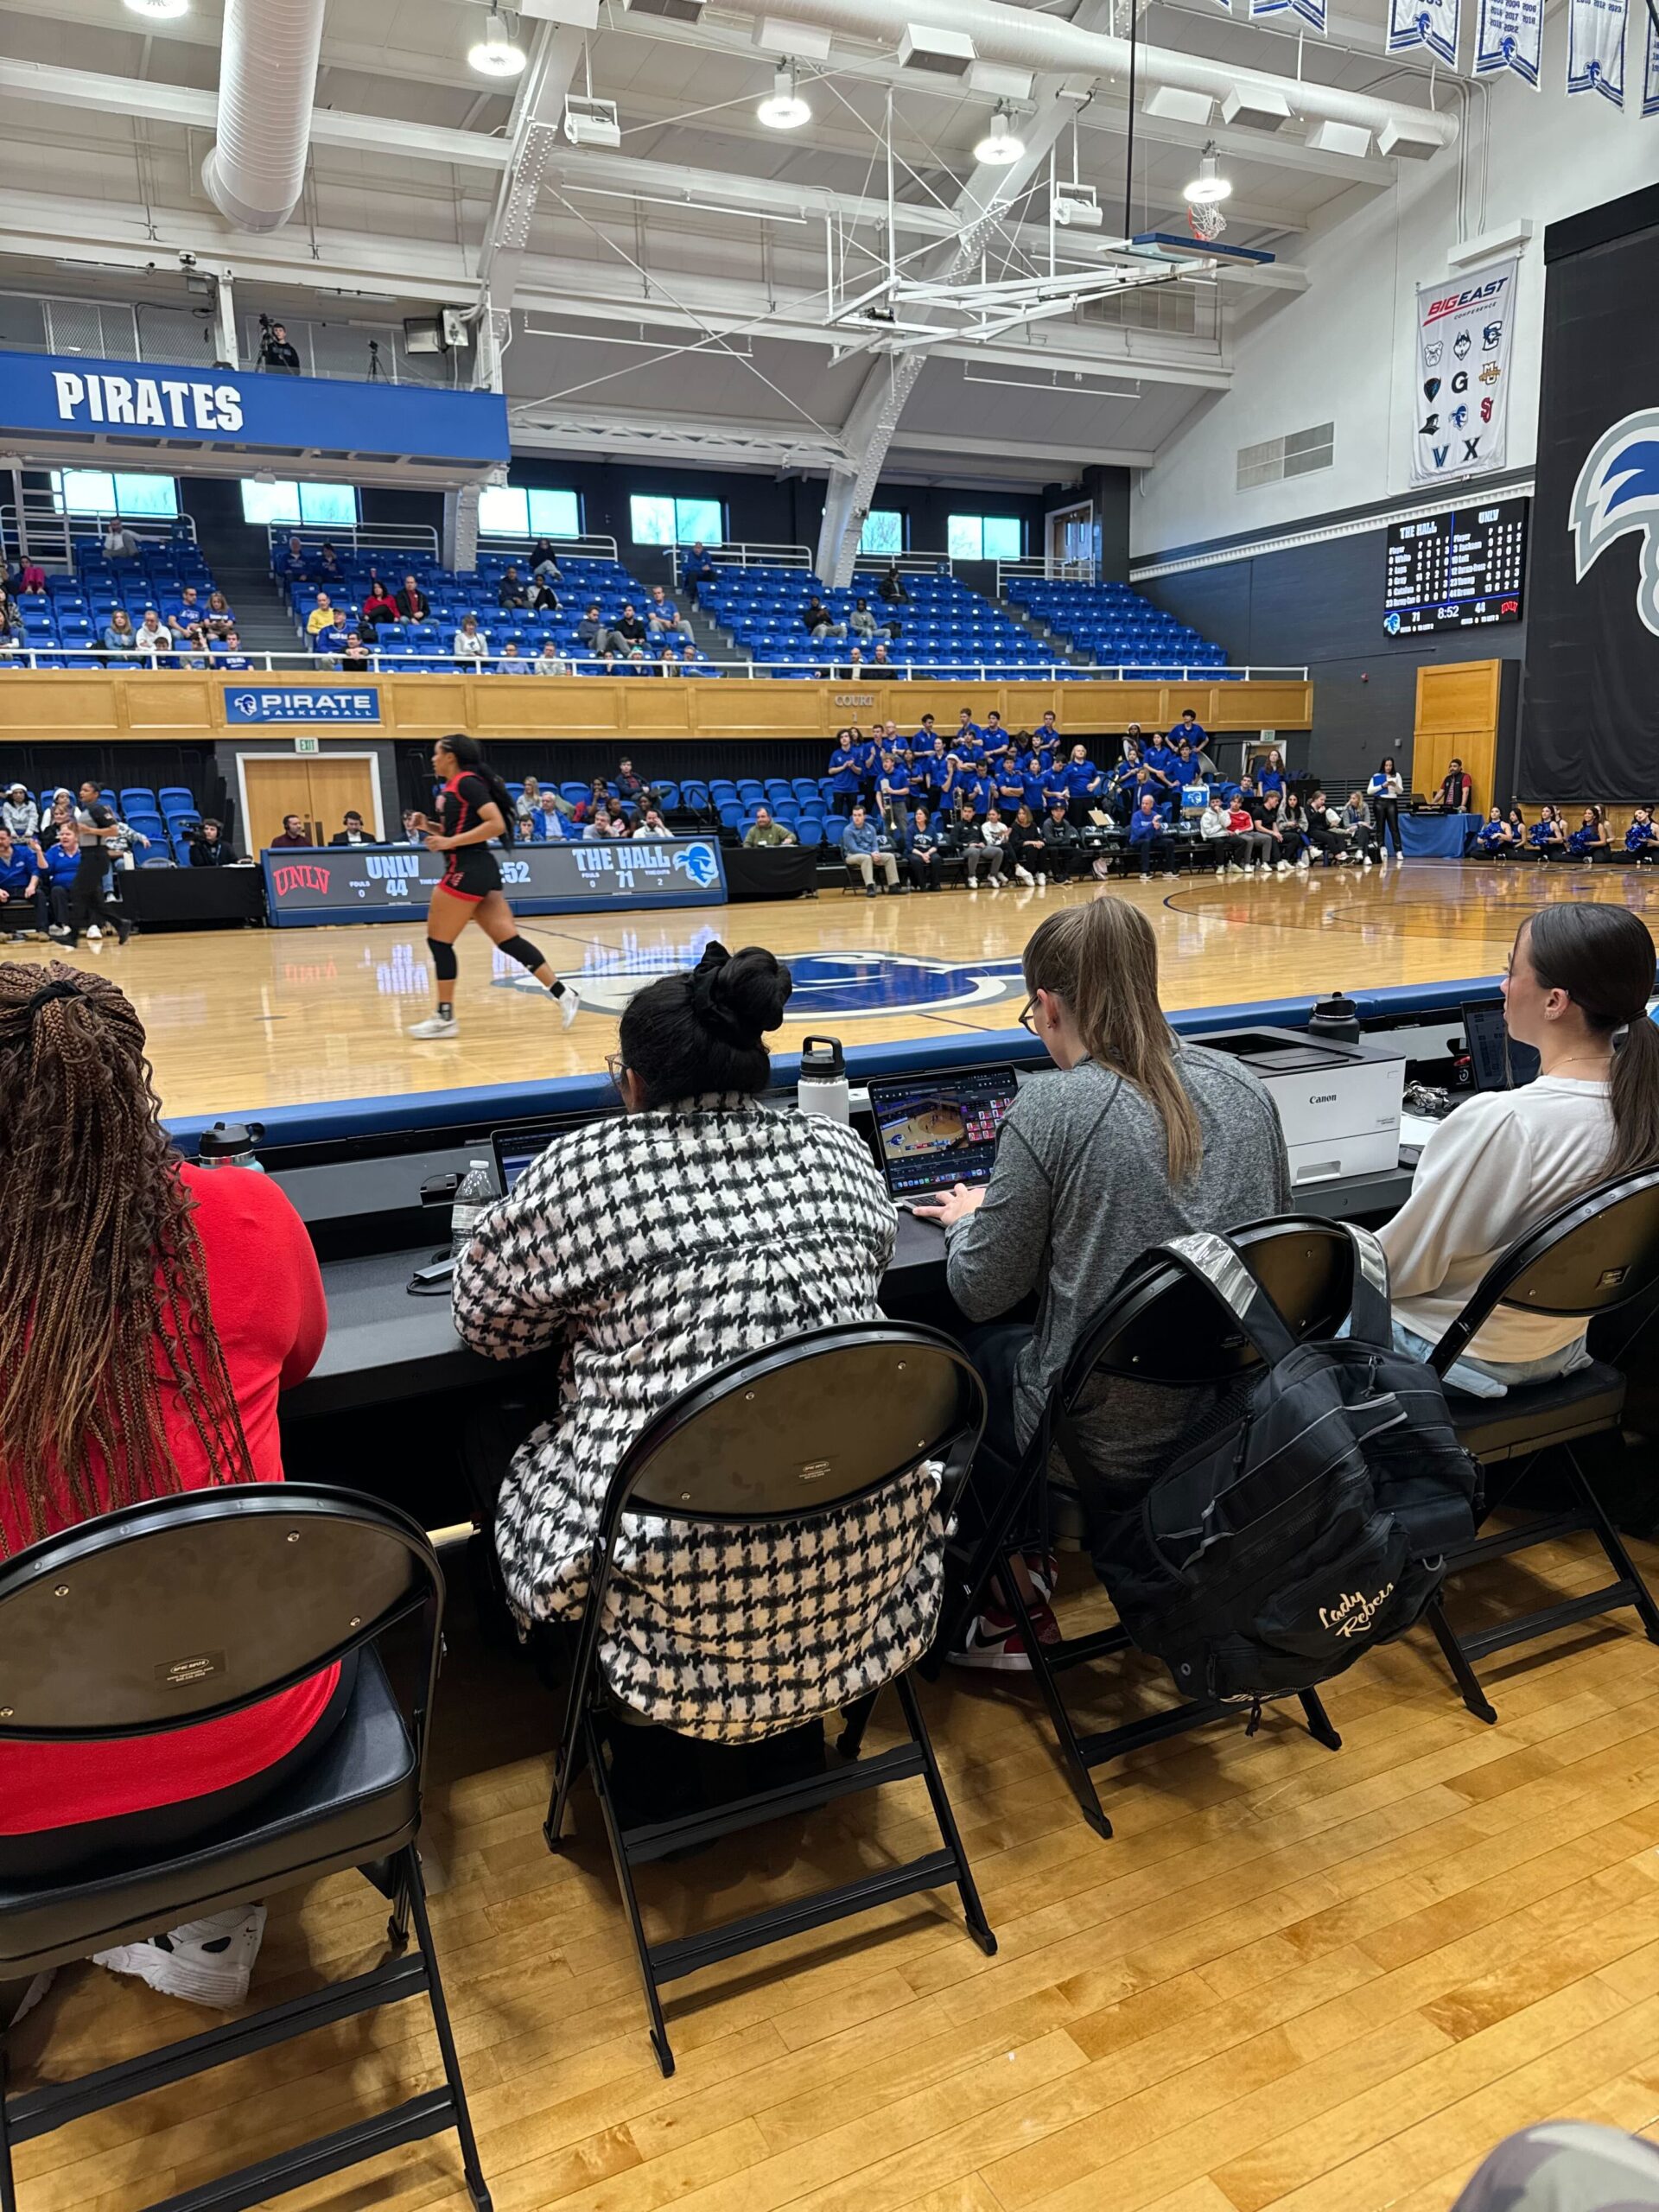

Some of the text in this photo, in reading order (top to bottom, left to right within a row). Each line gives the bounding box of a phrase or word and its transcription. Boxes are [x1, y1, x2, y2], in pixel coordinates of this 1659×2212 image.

[52, 372, 244, 431] PIRATES
[1433, 435, 1483, 467] V X
[1478, 508, 1499, 524] UNLV
[1400, 521, 1437, 539] THE HALL
[1412, 611, 1421, 622] 71
[1438, 605, 1459, 619] 8:52
[1475, 601, 1485, 613] 44
[261, 695, 372, 709] PIRATE
[835, 695, 874, 707] COURT
[299, 740, 315, 751] EXIT
[365, 855, 419, 879] UNLV
[572, 846, 671, 871] THE HALL
[273, 865, 330, 896] UNLV
[358, 879, 408, 898] 0 44
[615, 870, 634, 888] 71
[1309, 1094, 1337, 1104] Canon
[1319, 1592, 1366, 1630] Lady
[1335, 1582, 1394, 1637] Rebels
